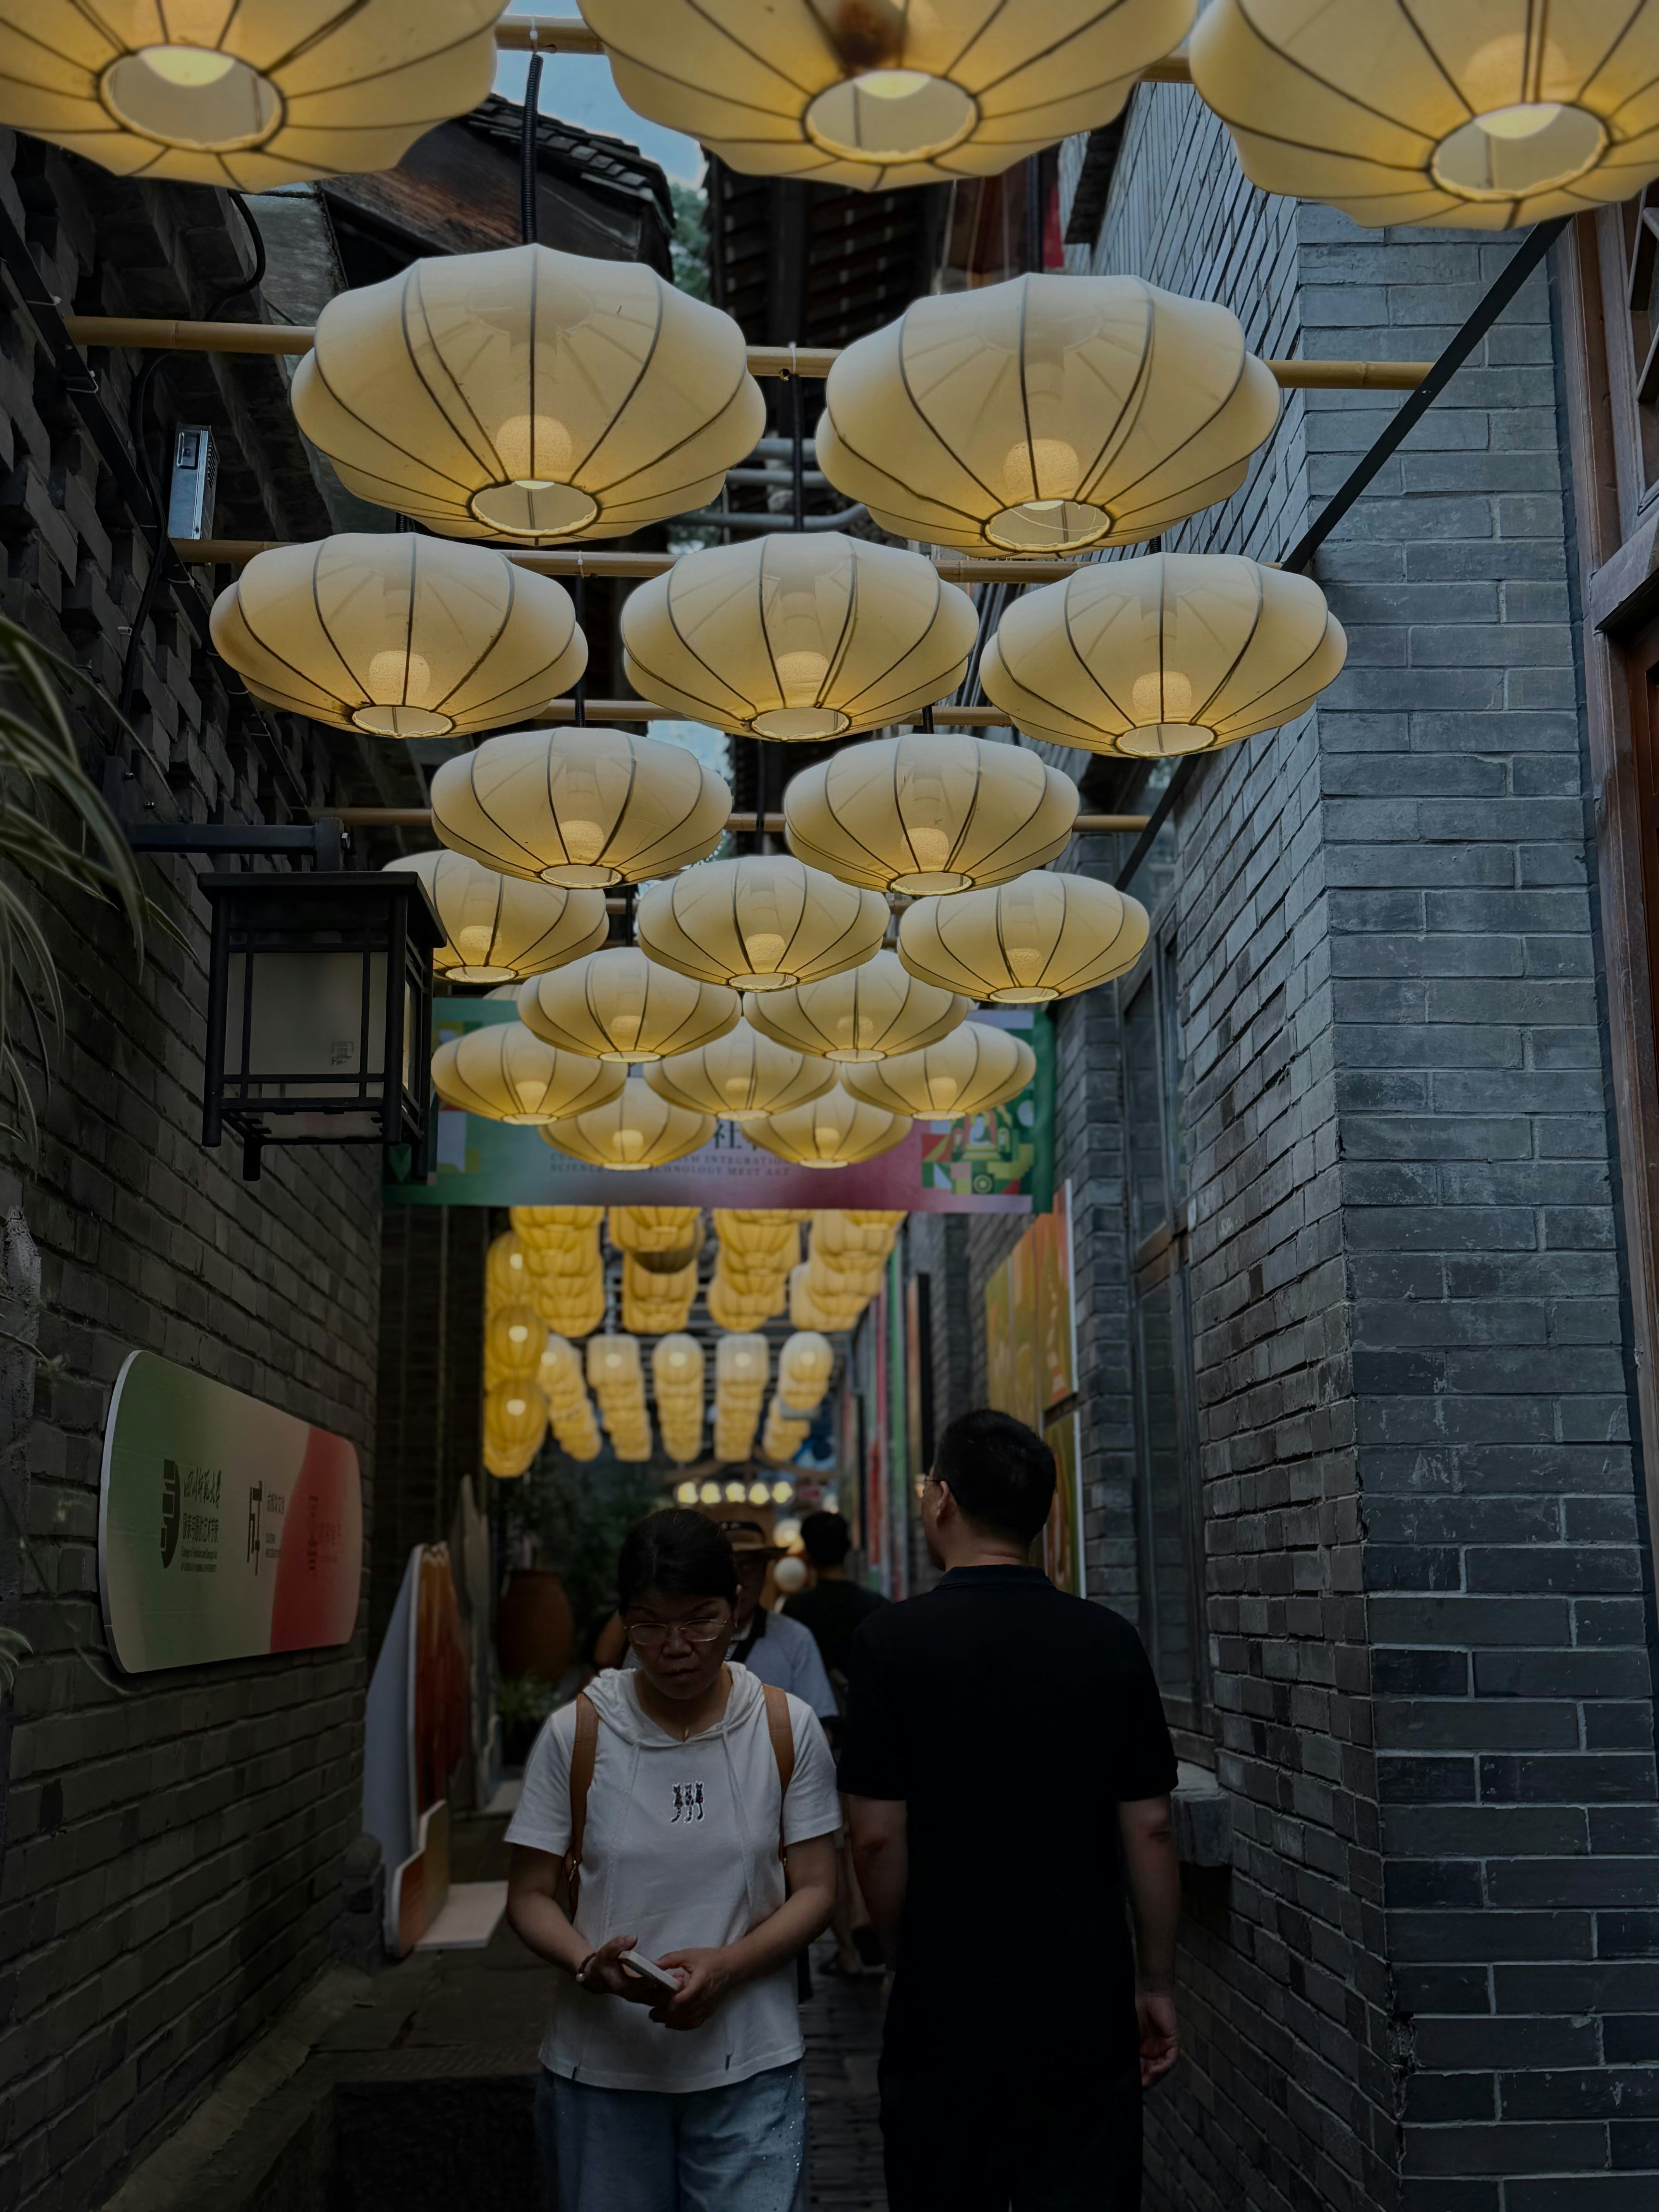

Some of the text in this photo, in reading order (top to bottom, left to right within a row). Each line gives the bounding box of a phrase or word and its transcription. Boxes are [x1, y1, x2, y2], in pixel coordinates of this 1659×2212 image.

[705, 1155, 785, 1164] INTEGRATIO
[728, 1167, 761, 1176] MEET
[766, 1168, 789, 1176] ART
